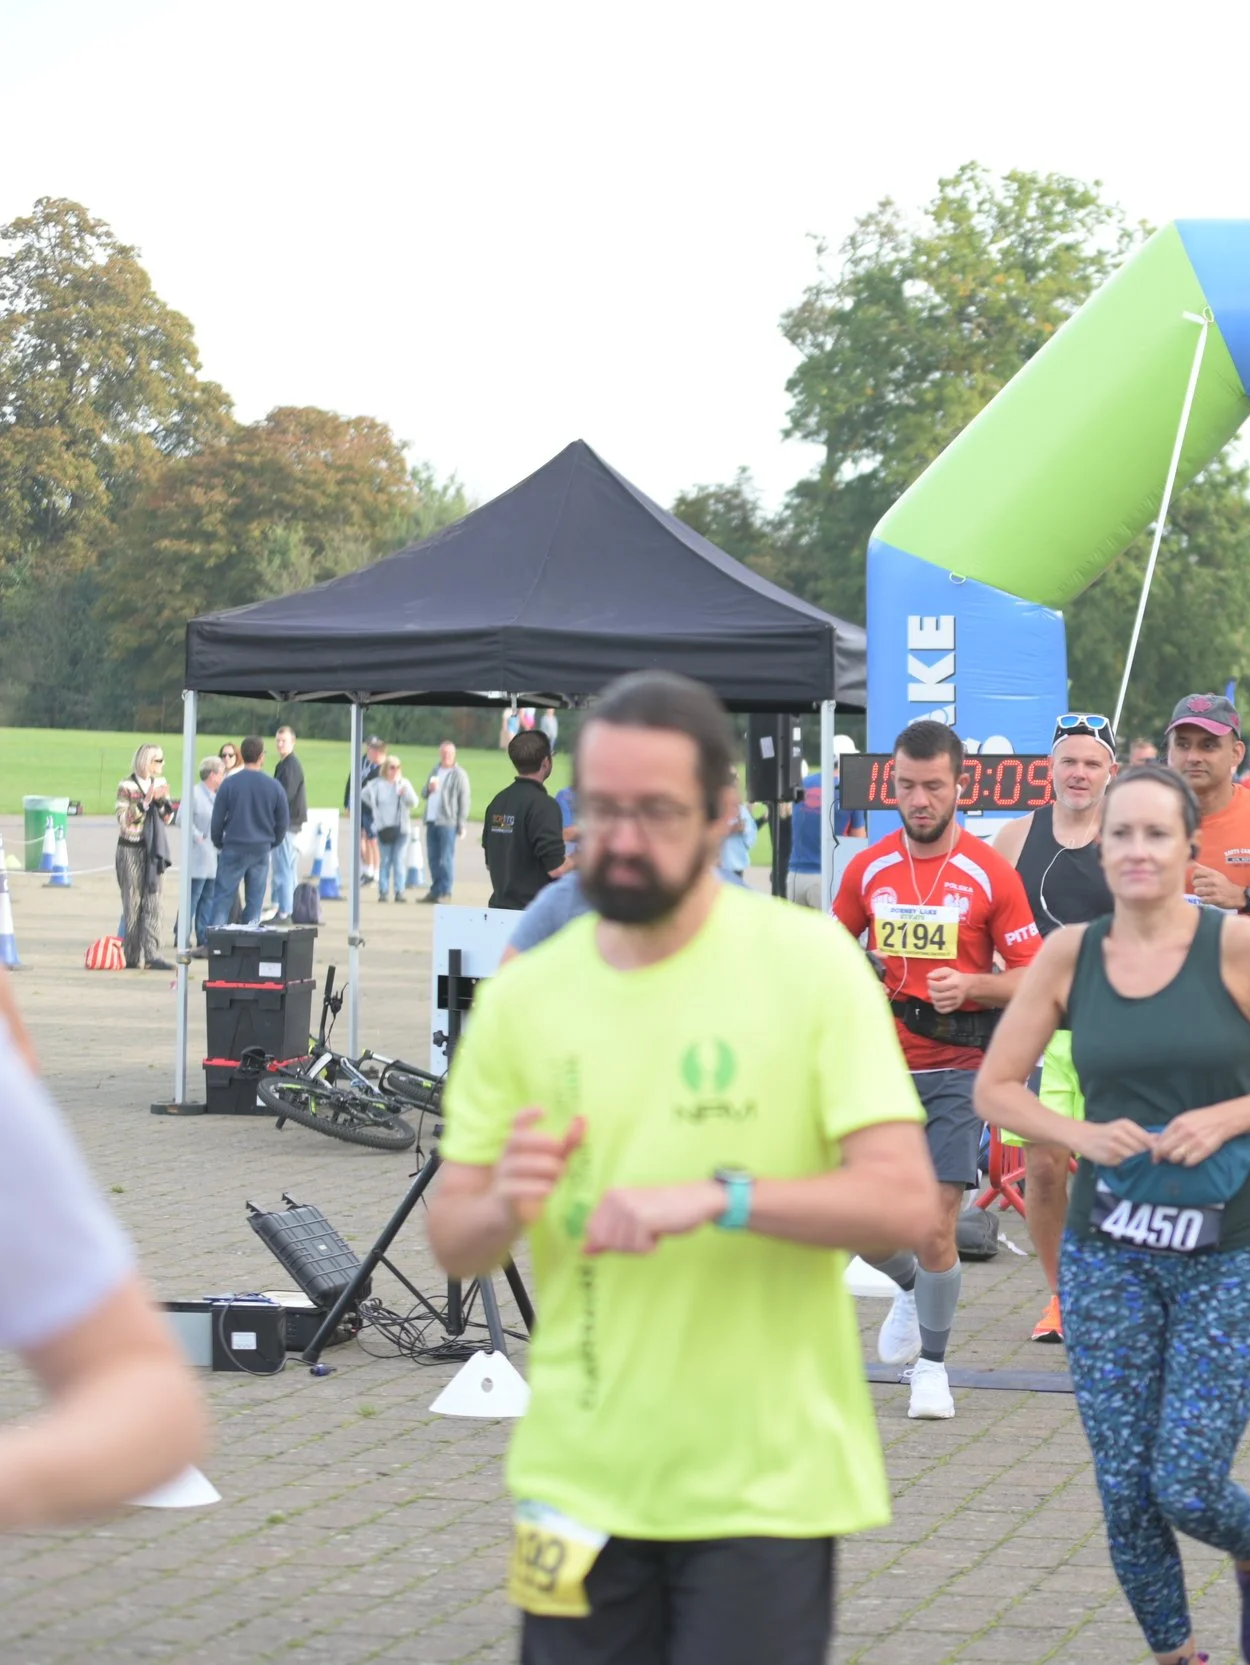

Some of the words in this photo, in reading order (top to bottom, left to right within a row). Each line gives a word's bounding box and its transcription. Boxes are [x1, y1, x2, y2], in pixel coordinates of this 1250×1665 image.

[944, 881, 974, 893] POLSKA
[881, 920, 946, 951] 2194
[1101, 1200, 1204, 1252] 4450
